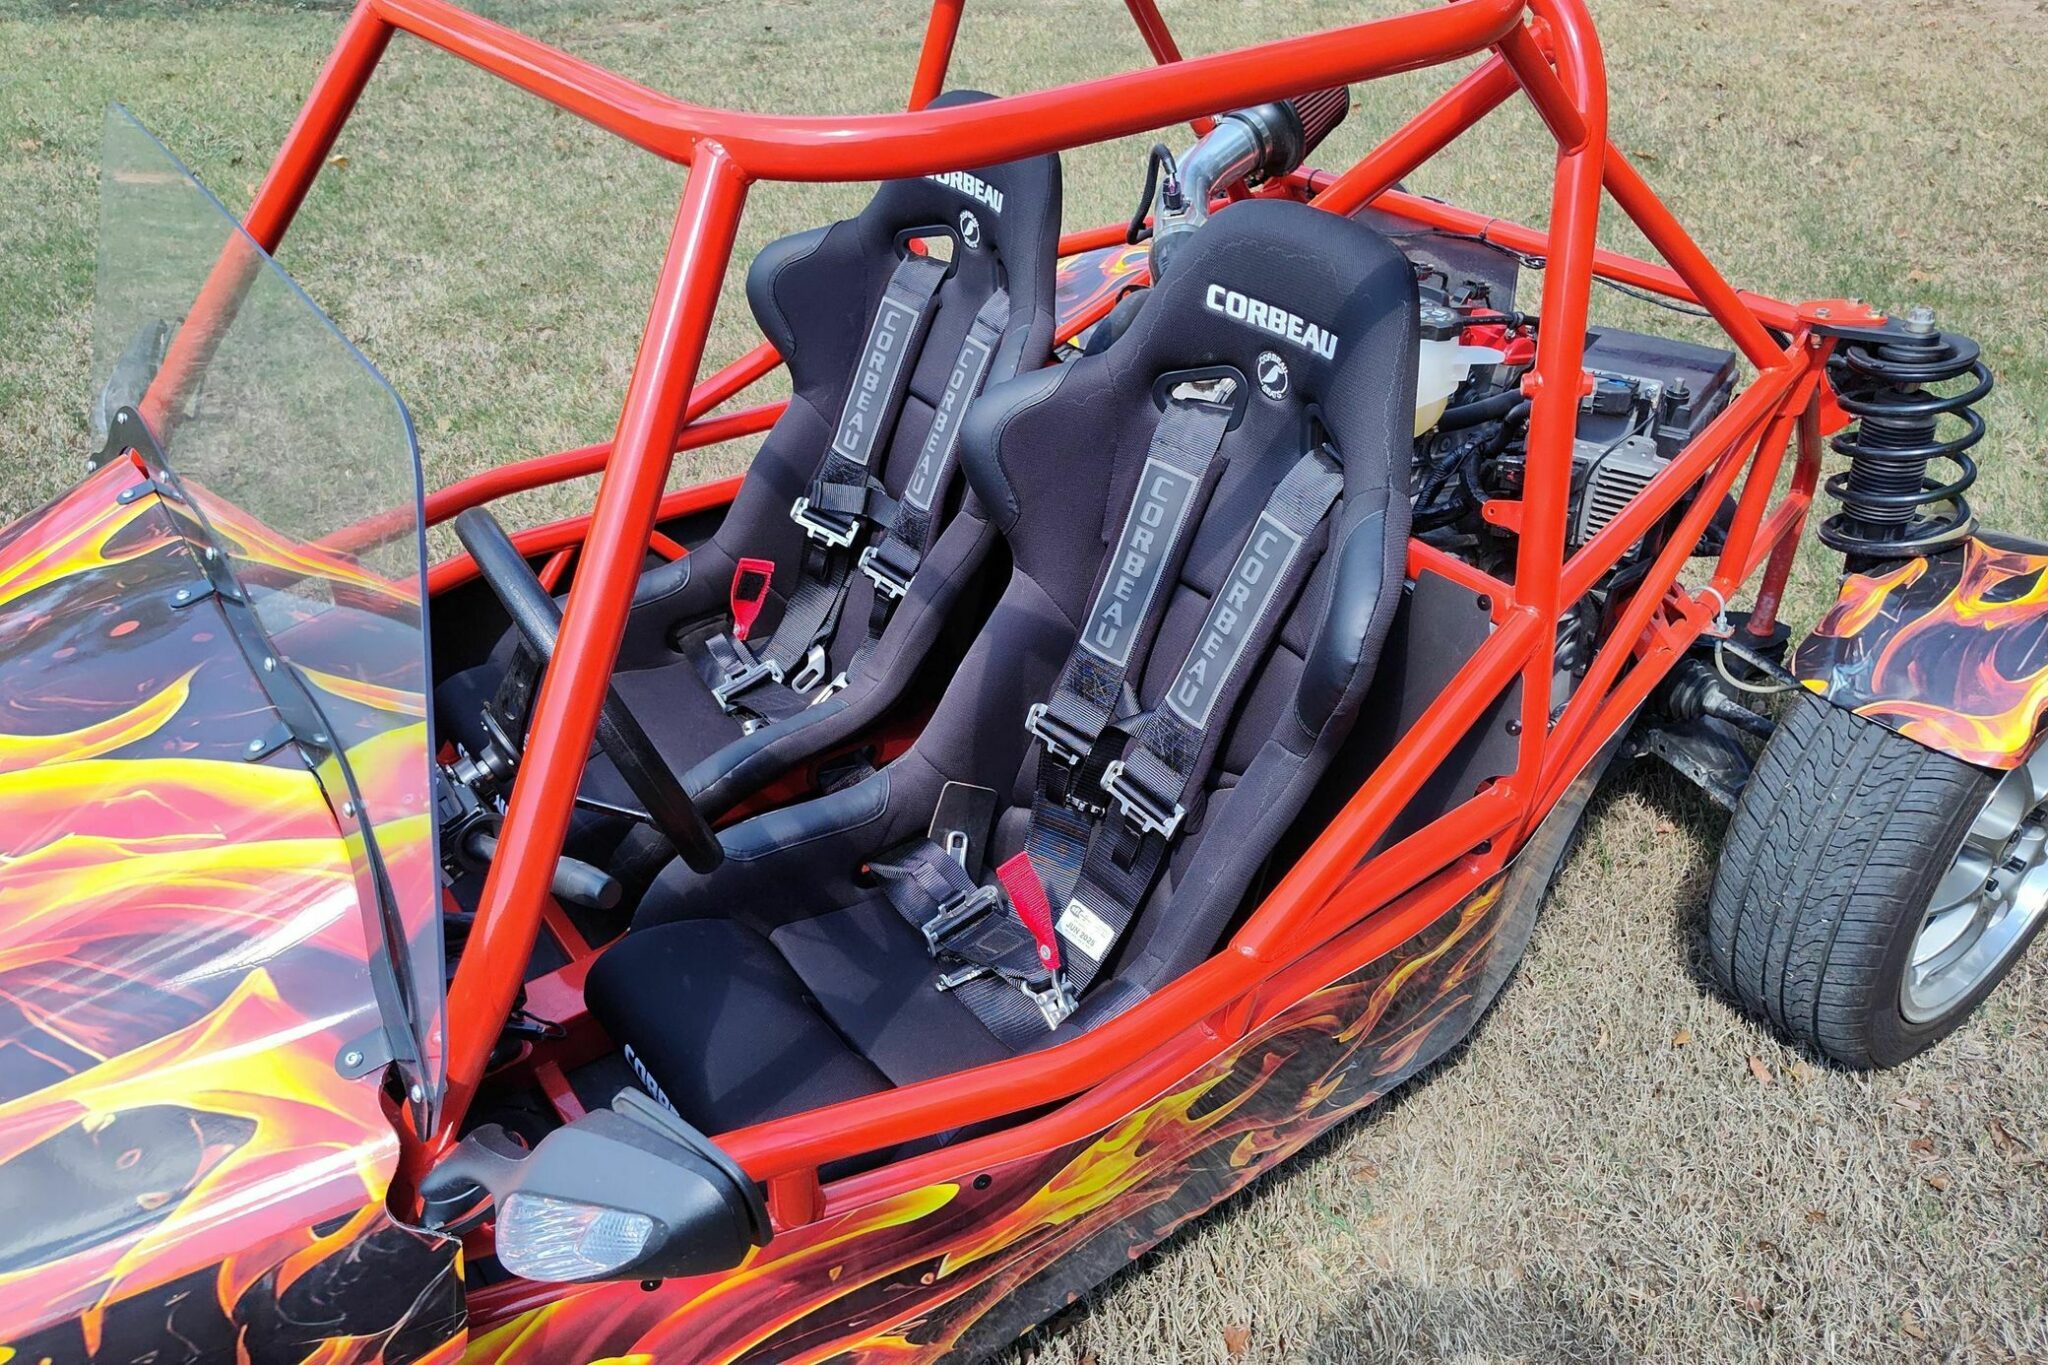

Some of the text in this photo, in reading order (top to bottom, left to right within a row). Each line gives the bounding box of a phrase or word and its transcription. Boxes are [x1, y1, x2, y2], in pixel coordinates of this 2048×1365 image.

[924, 171, 1004, 214] RBEAU
[1206, 283, 1339, 361] CORBEAU
[843, 310, 901, 451] CORBEAU
[913, 347, 975, 495] CORBEAU
[1095, 475, 1174, 649] CORBEAU
[1177, 530, 1279, 707] CORBEAU
[1065, 922, 1081, 935] JUN
[624, 1044, 680, 1118] CORB
